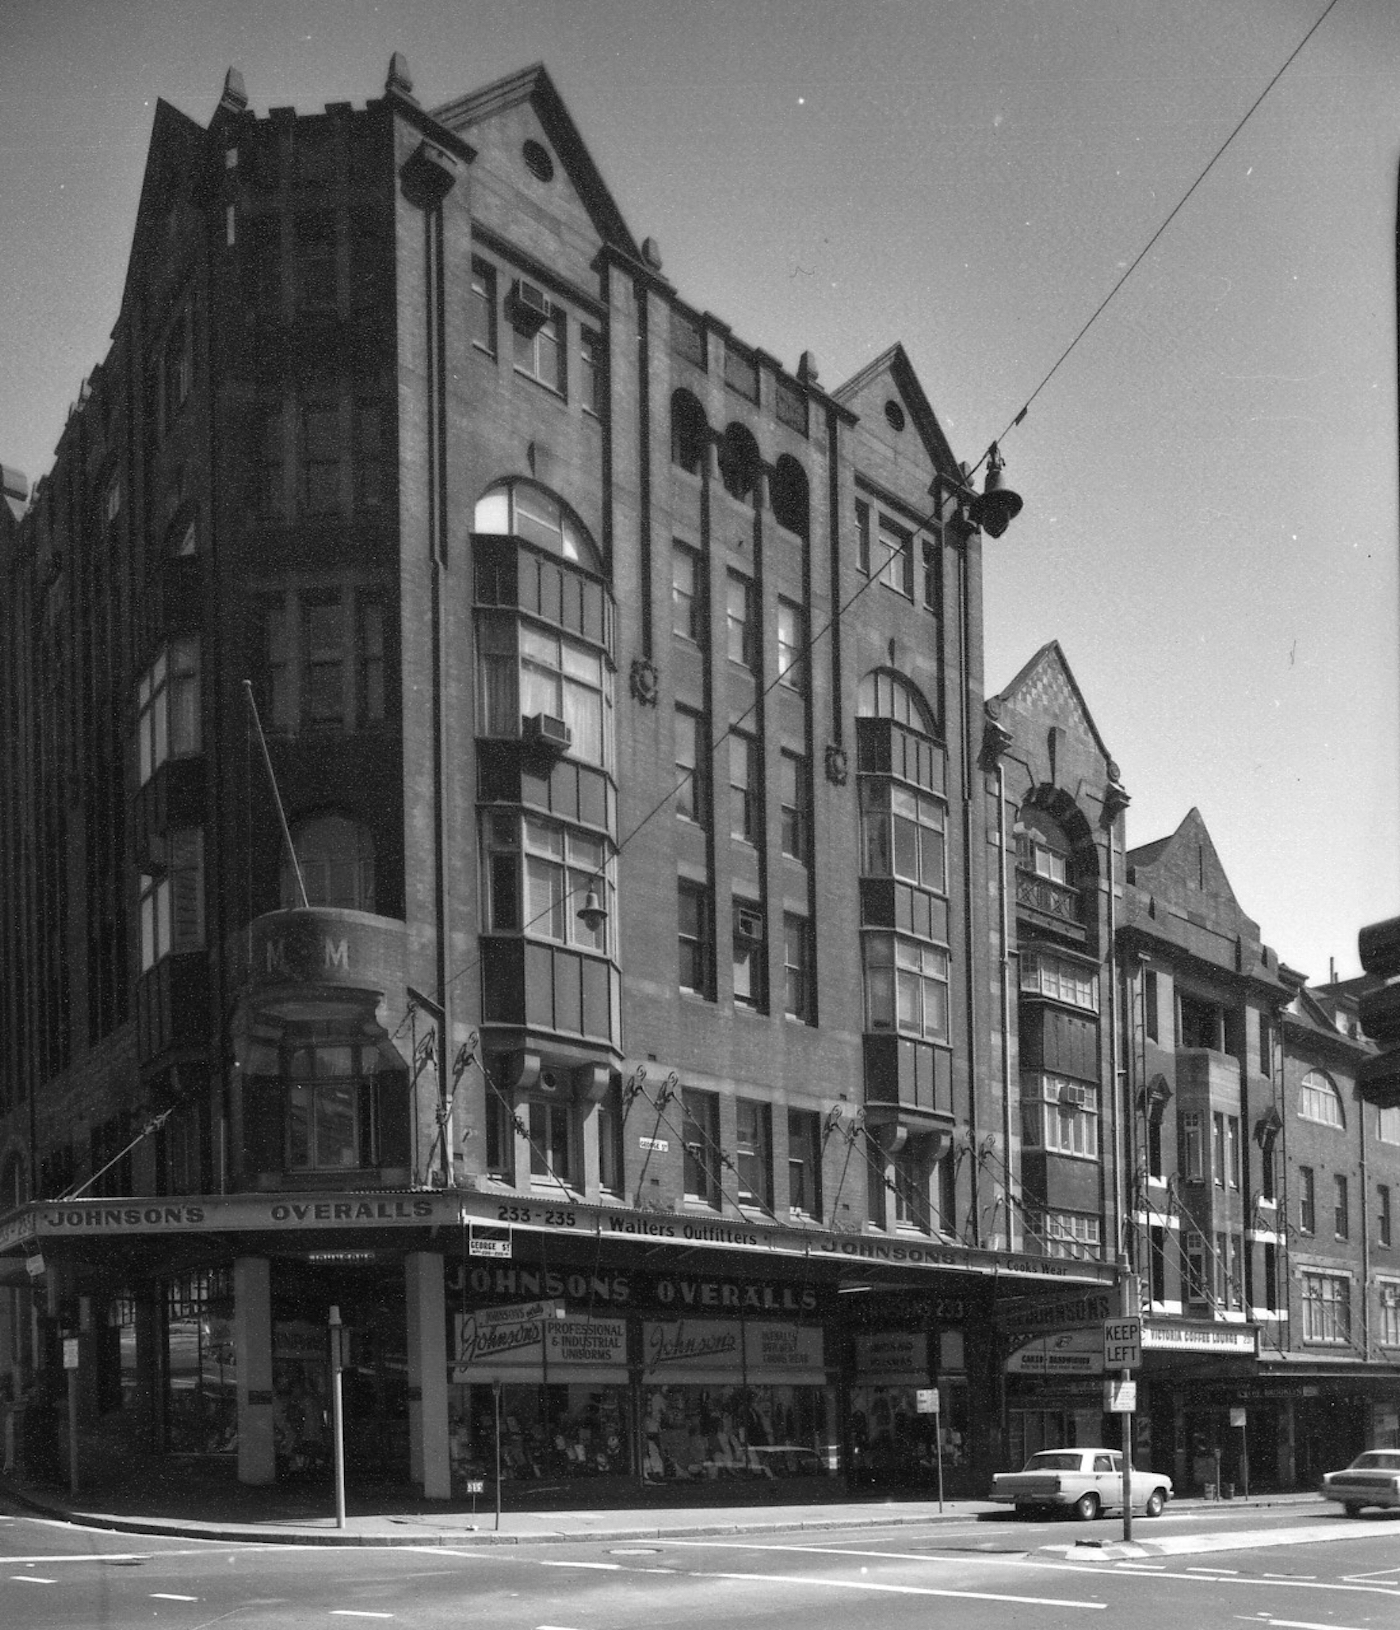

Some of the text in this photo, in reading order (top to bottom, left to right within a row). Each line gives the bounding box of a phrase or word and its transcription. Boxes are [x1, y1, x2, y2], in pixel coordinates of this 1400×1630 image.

[325, 936, 350, 971] M
[47, 1201, 433, 1227] JOHNSON'S OVERALLS
[609, 1216, 675, 1237] Waiters
[683, 1224, 757, 1245] Outfitters
[471, 1241, 497, 1250] GEORGE
[1007, 1260, 1038, 1273] Cooks
[1041, 1263, 1068, 1276] Wear
[657, 1280, 817, 1310] OVERALLS
[548, 1322, 624, 1337] PROFESSIONAL
[1106, 1325, 1138, 1341] KEEP
[1151, 1329, 1182, 1342] VICTORIA
[1184, 1331, 1211, 1343] COFFEE
[551, 1336, 621, 1348] & INDUSTRIAL
[1108, 1346, 1137, 1362] LEFT
